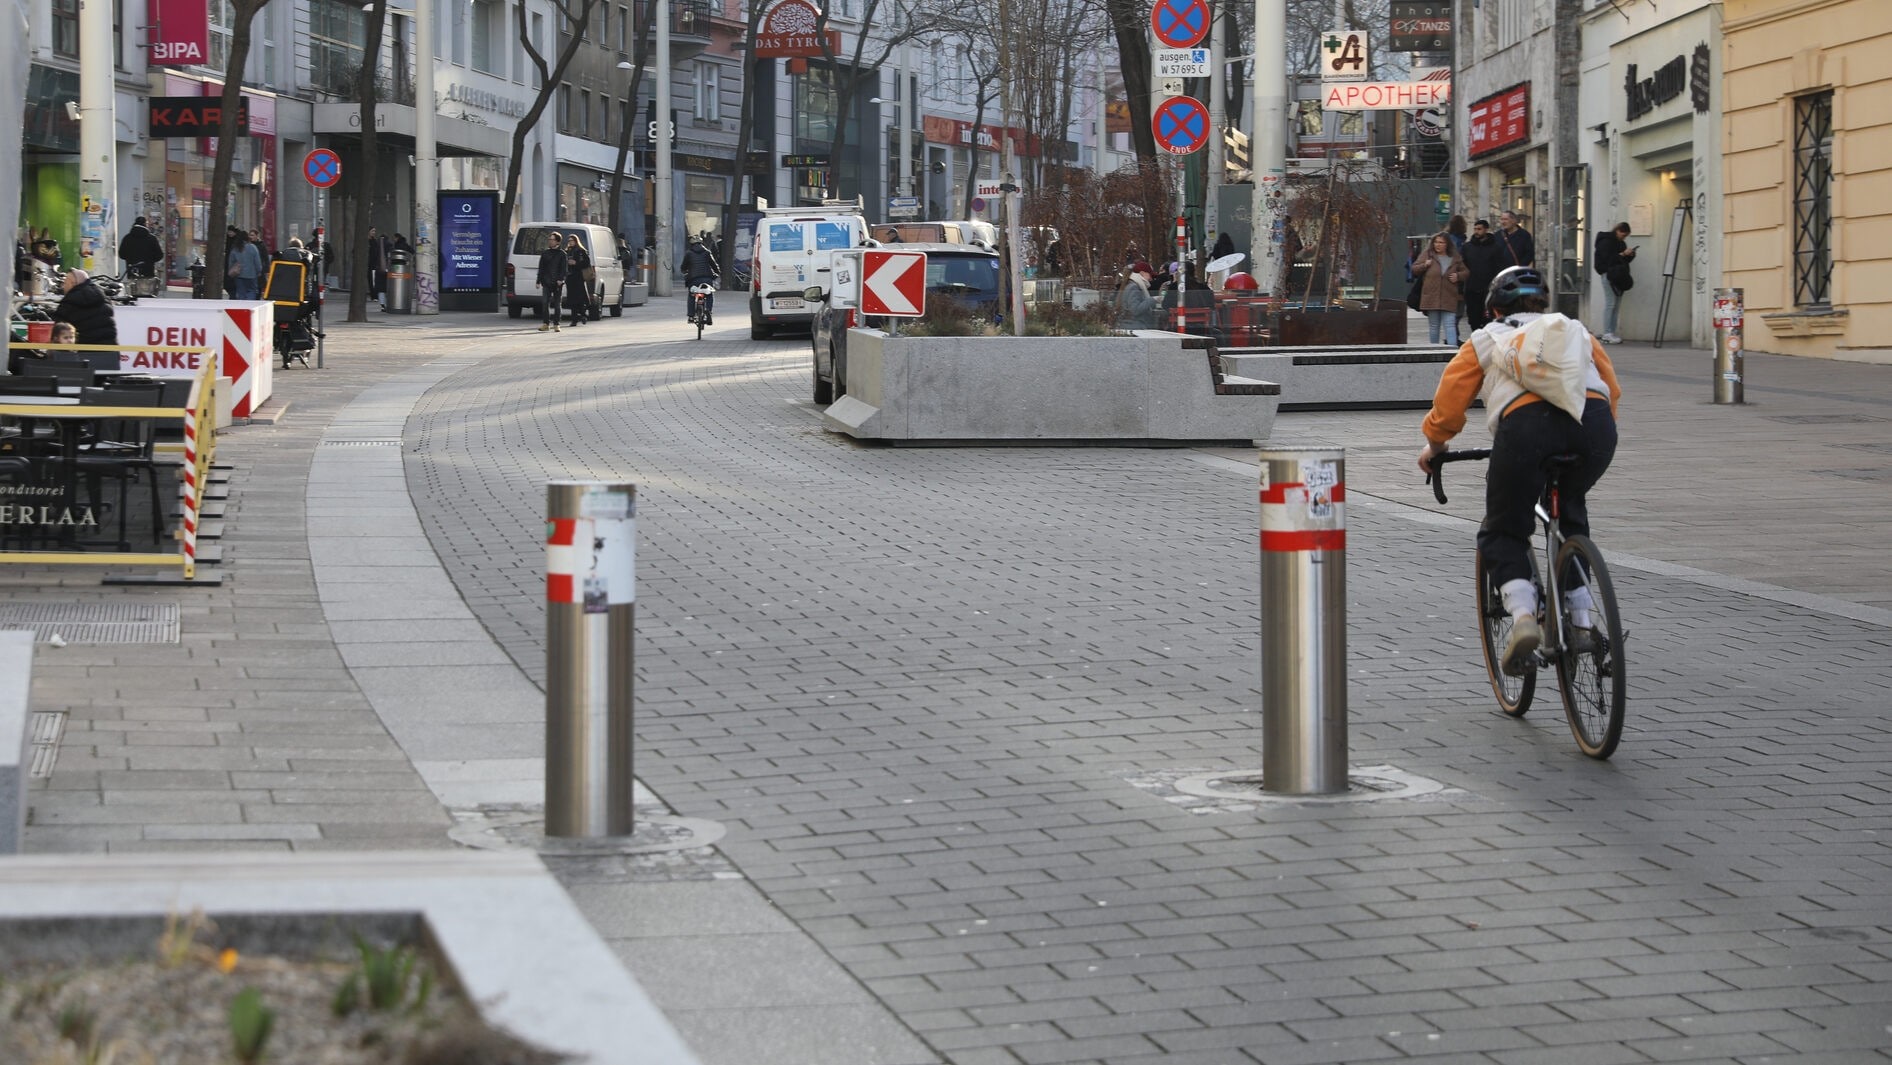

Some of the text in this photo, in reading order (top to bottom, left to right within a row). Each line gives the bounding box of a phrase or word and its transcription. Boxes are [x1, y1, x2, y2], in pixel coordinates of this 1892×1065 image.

[755, 38, 780, 48] DAS
[154, 42, 201, 59] BIPA
[1159, 53, 1191, 63] ausgen.
[1161, 65, 1169, 74] W
[961, 123, 993, 146] inrio
[1169, 145, 1192, 154] ENDE
[978, 184, 1020, 195] inteo
[147, 326, 206, 347] DEIN
[132, 351, 218, 370] ANKE
[0, 505, 98, 526] ERLAA
